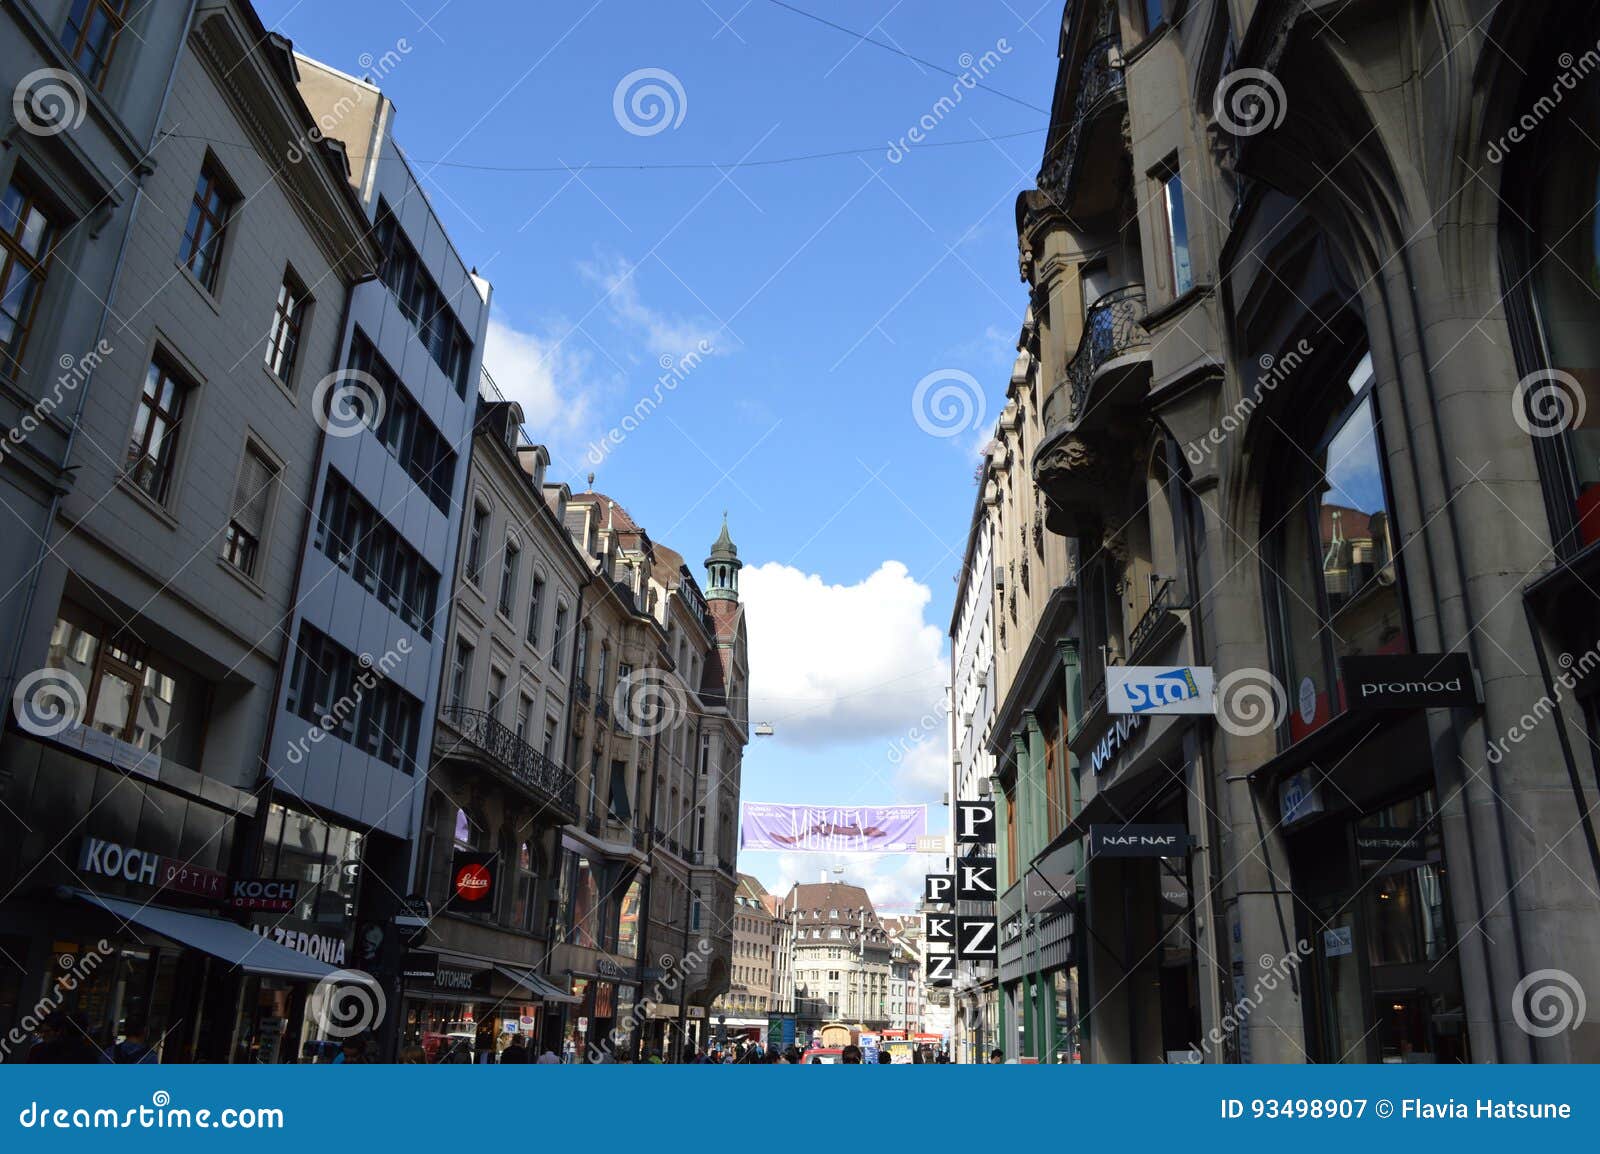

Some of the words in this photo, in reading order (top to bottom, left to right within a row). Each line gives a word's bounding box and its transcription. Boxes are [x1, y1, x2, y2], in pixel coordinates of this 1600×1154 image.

[1361, 678, 1461, 697] promod
[1092, 727, 1115, 776] NAF
[1102, 836, 1138, 845] NAF
[1141, 836, 1177, 845] NAF
[86, 838, 159, 886] KOCH
[167, 866, 218, 892] OPTIK
[233, 880, 296, 899] KOCH
[456, 872, 488, 888] Leica
[236, 899, 288, 908] OPTIK
[434, 970, 473, 989] OTOHAUS
